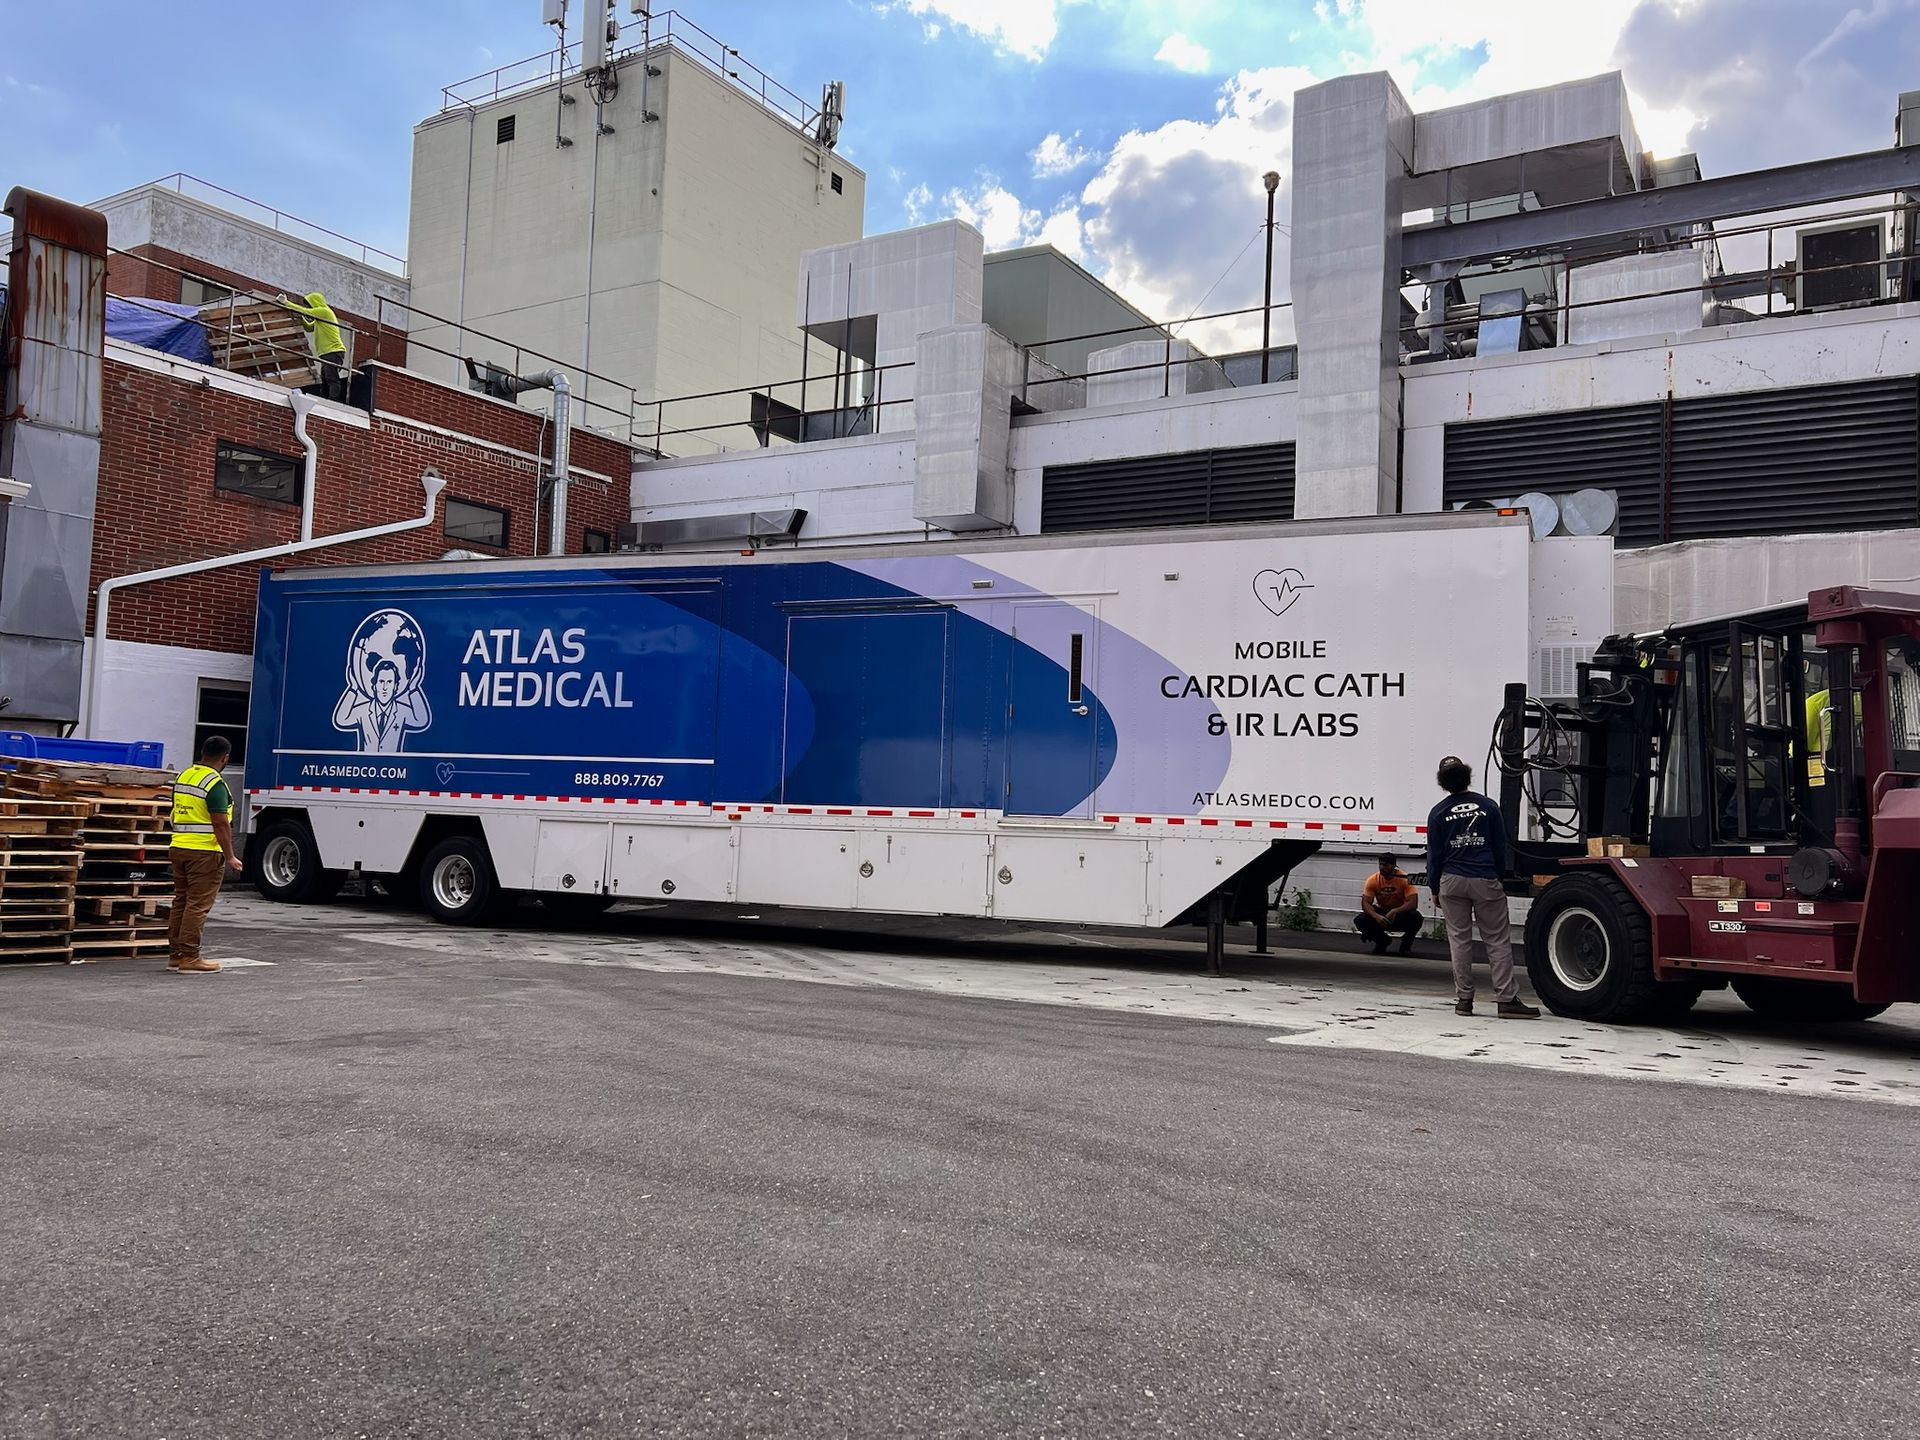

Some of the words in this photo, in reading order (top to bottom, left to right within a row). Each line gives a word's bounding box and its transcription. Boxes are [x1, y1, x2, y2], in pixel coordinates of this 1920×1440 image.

[462, 628, 586, 664] ATLAS
[1235, 640, 1326, 660] MOBILE
[458, 671, 634, 708] MEDICAL
[1160, 674, 1305, 698] CARDIAC
[1314, 672, 1405, 697] CATH
[1207, 713, 1228, 737] &
[1236, 713, 1265, 737] IR
[1273, 713, 1360, 737] LABS
[302, 764, 406, 779] ATLASMEDCO.COM
[574, 773, 665, 788] 888.809.7767
[1192, 792, 1374, 810] ATLASMEDCO.COM
[1445, 811, 1487, 822] DUGGAN
